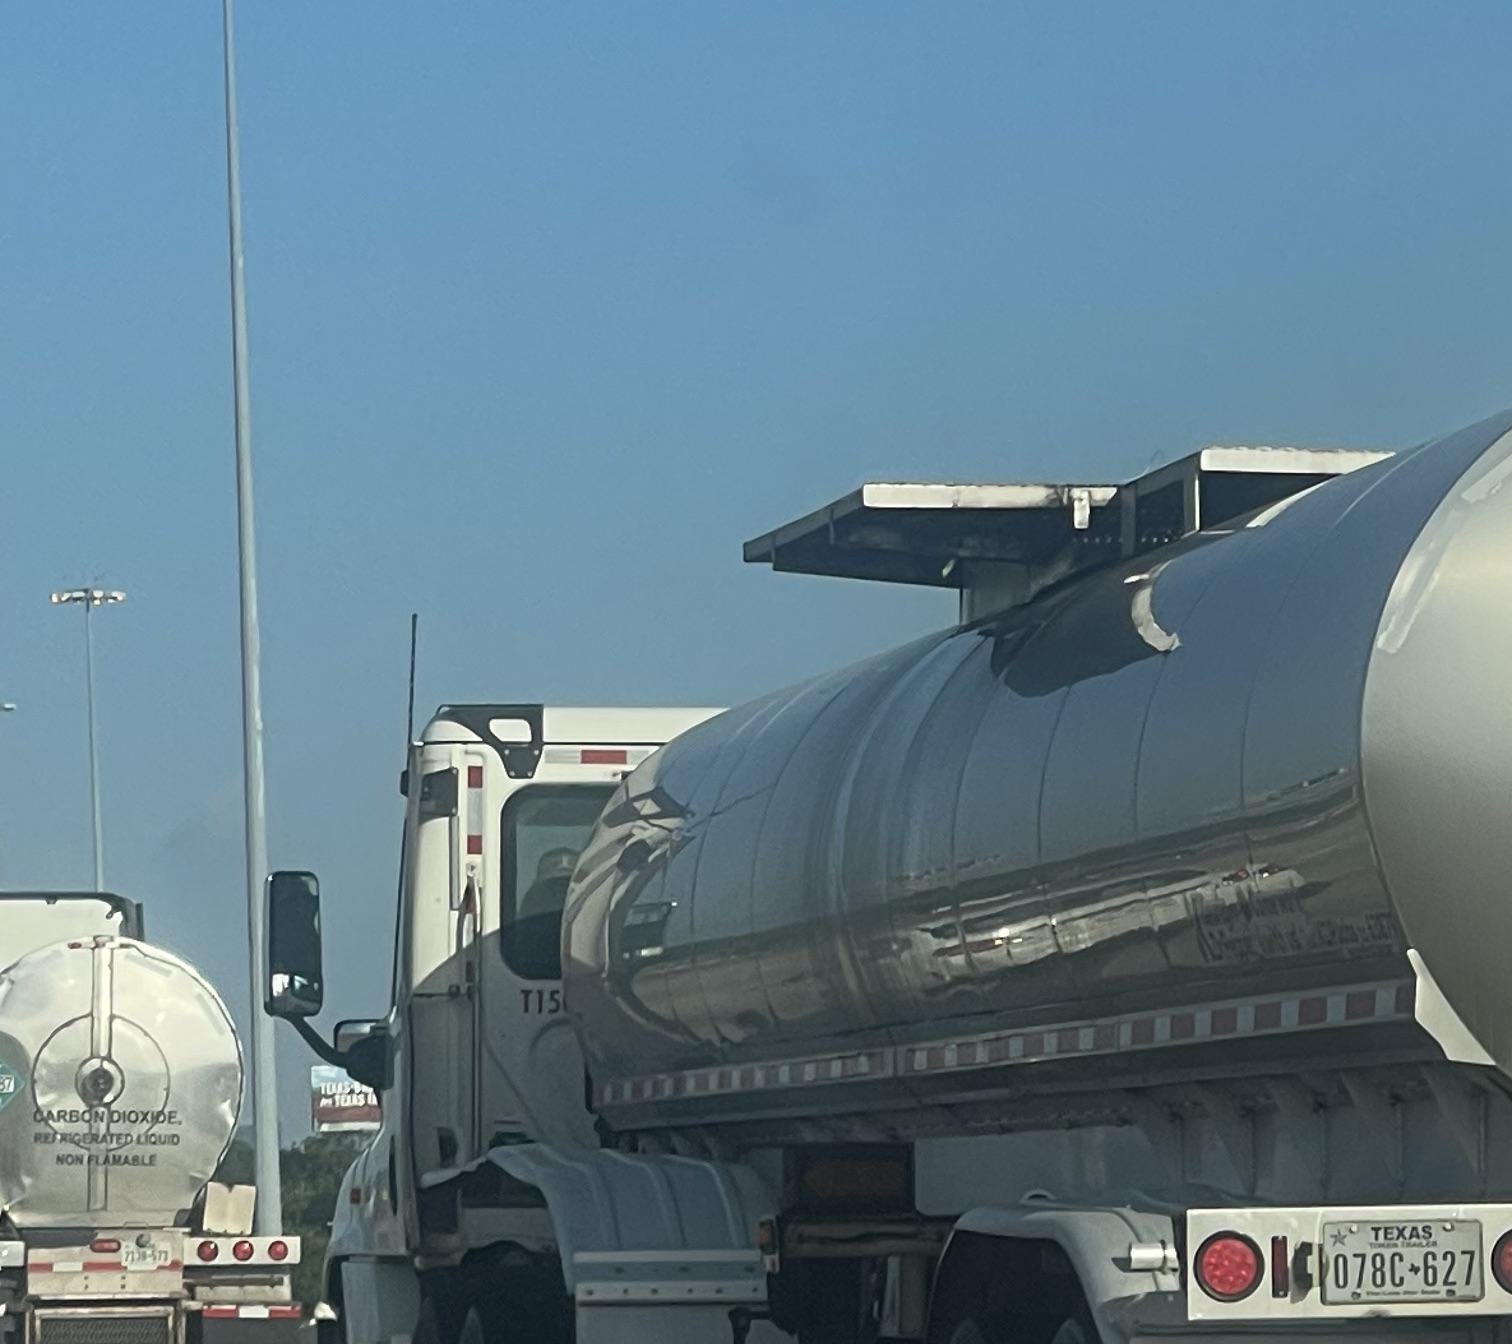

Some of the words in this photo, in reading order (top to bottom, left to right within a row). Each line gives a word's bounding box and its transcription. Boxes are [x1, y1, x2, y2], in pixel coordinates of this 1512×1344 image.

[520, 989, 567, 1014] T15
[33, 1109, 105, 1124] CARBON
[33, 1132, 134, 1146] REFRIGERATED
[136, 1132, 181, 1146] LIQUID
[55, 1153, 84, 1166] NON
[1371, 1225, 1433, 1242] TEXAS
